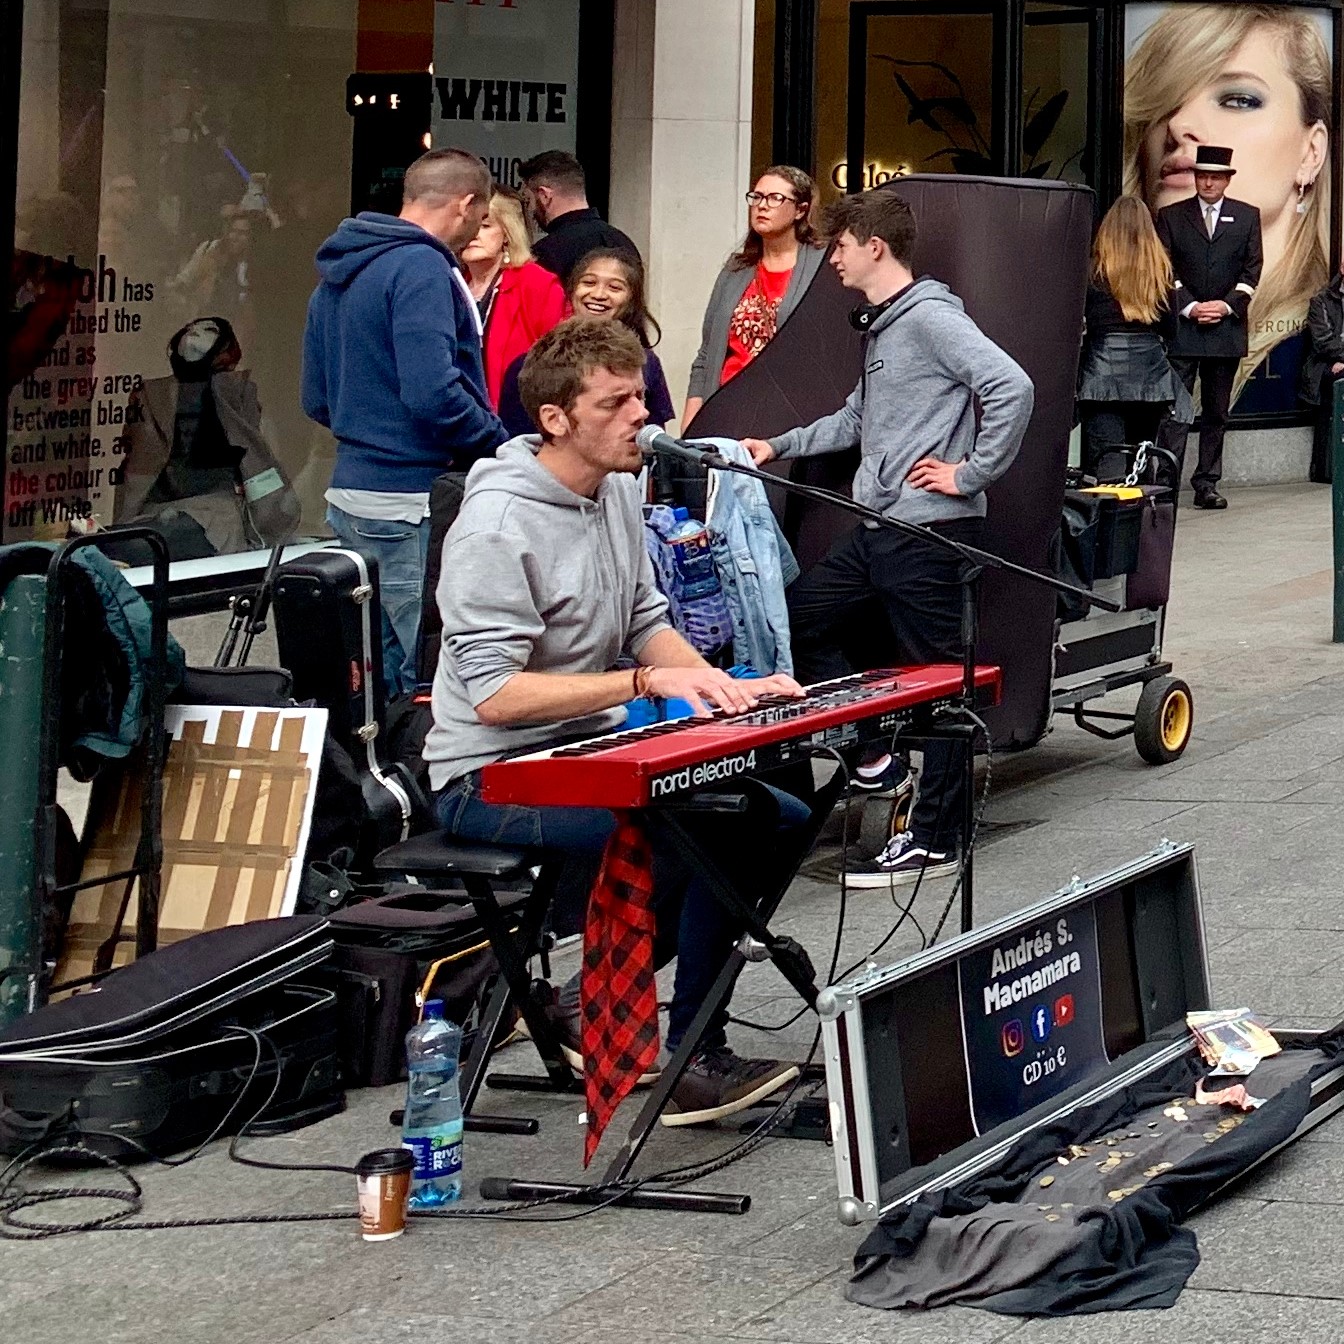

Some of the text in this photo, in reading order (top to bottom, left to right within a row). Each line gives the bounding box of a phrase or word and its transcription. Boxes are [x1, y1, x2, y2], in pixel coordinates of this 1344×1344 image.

[435, 77, 568, 123] WHITE
[123, 276, 154, 302] has
[114, 307, 141, 333] the
[75, 345, 97, 366] as
[22, 374, 144, 405] the grey area
[13, 400, 145, 432] between black
[11, 435, 47, 465] and
[51, 432, 106, 461] white,
[9, 467, 39, 496] the
[45, 465, 104, 493] colour
[651, 767, 690, 798] nord
[990, 918, 1073, 979] Andrés S.
[983, 950, 1082, 1016] Macnamara
[1023, 1060, 1042, 1086] CD
[1043, 1056, 1056, 1076] 10
